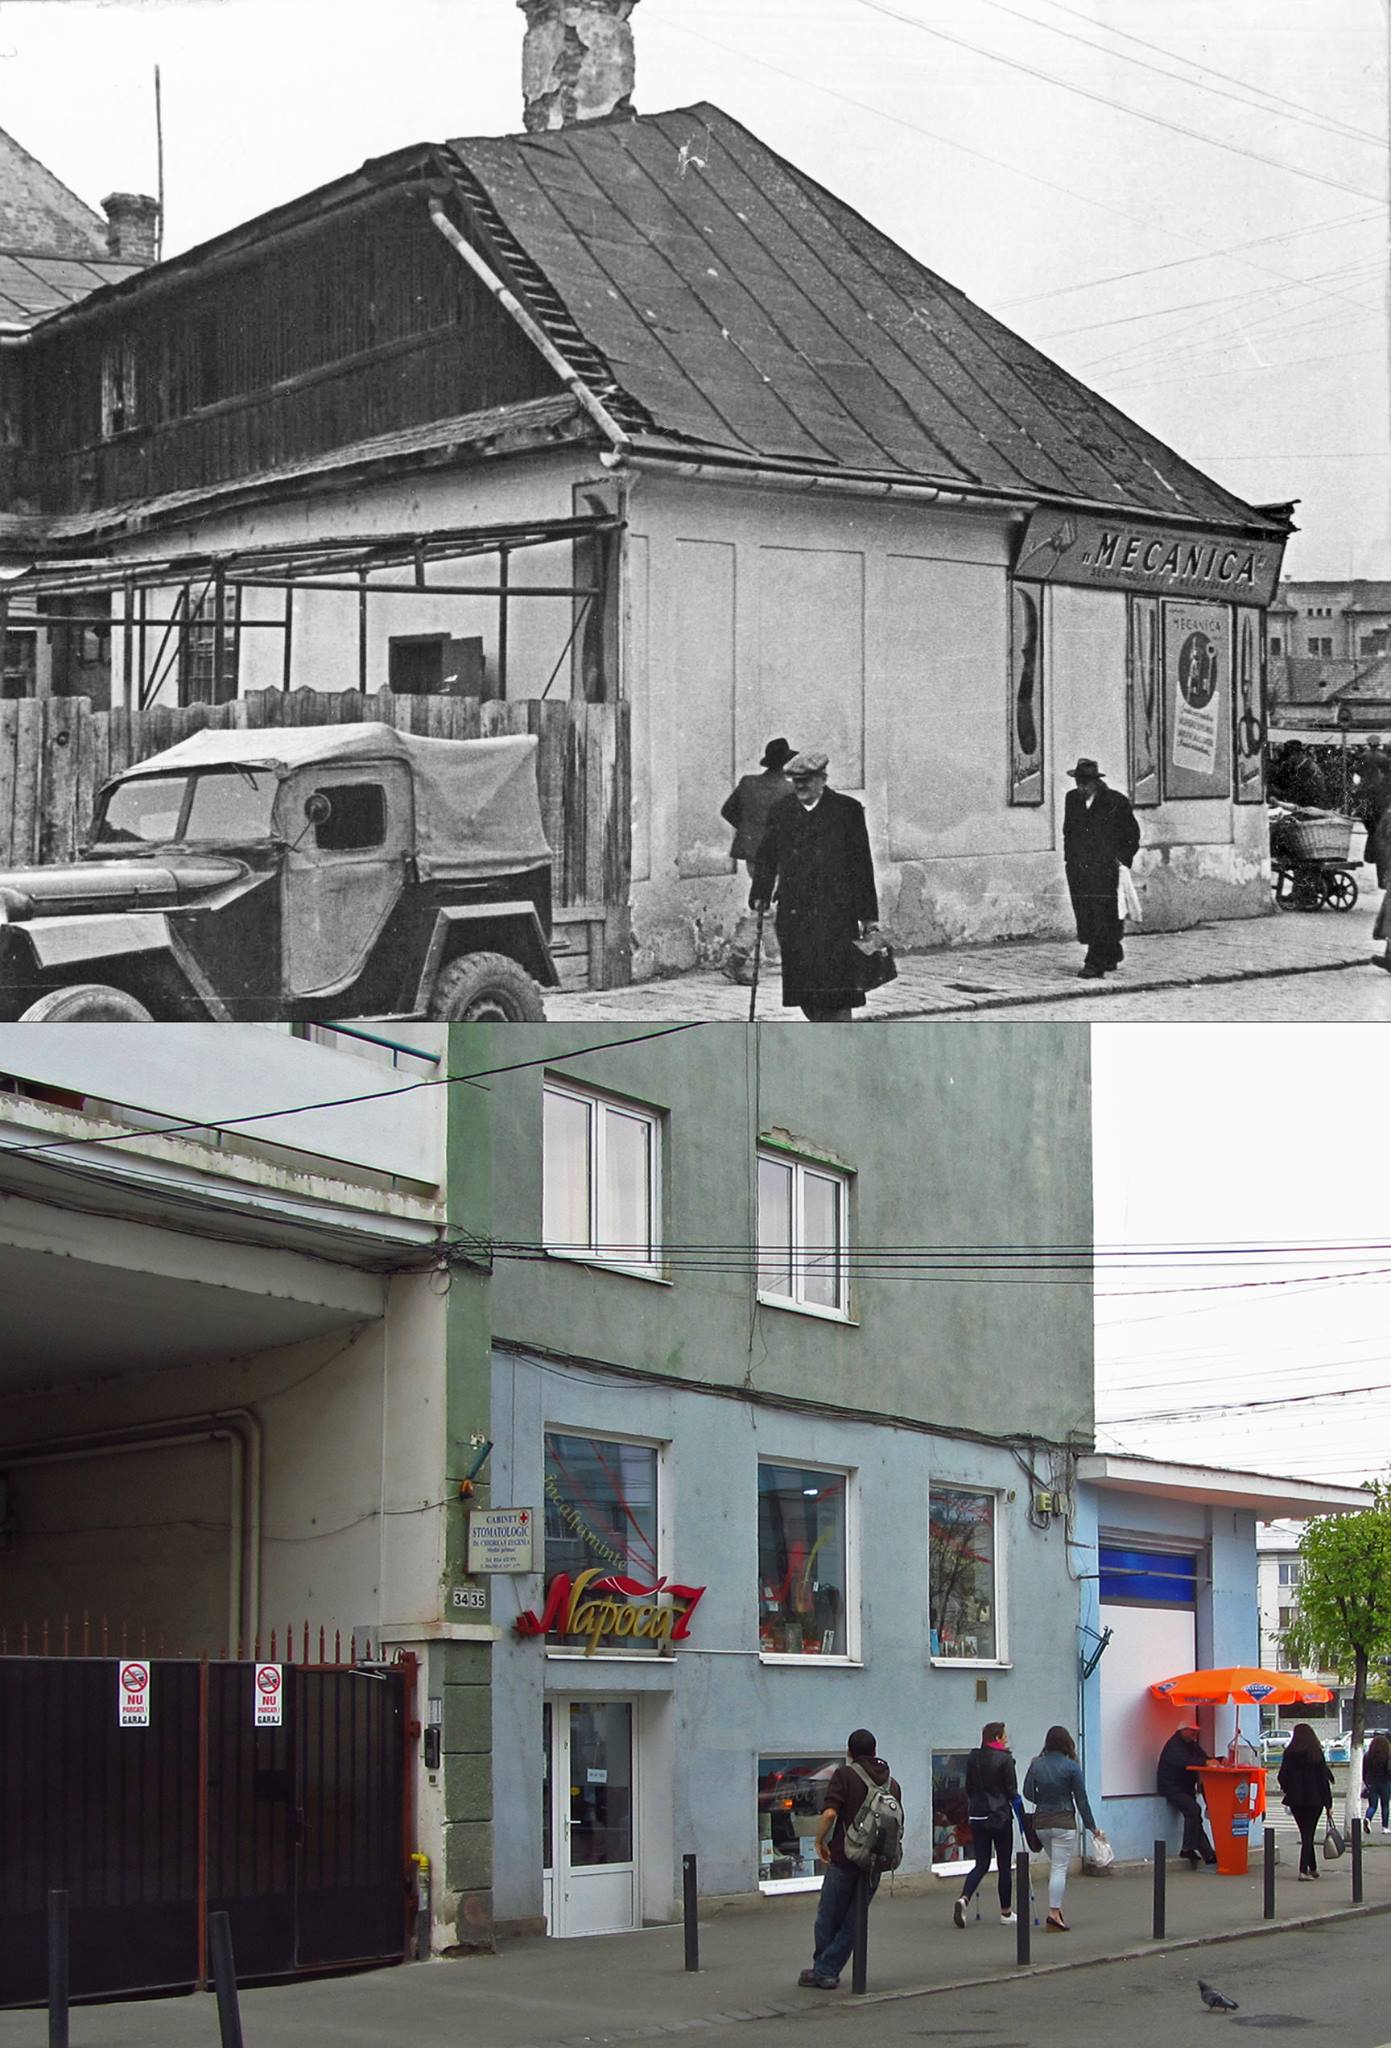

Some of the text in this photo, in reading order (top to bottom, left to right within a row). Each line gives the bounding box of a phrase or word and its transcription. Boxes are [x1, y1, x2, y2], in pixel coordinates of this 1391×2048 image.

[486, 1515, 517, 1524] CABINET
[472, 1527, 529, 1537] STOMATOLOGIC
[455, 1593, 468, 1605] 34
[472, 1594, 485, 1606] 35
[127, 1695, 143, 1705] NU
[262, 1695, 277, 1706] NU
[122, 1715, 147, 1725] GARAJ
[257, 1715, 280, 1724] GARAJ
